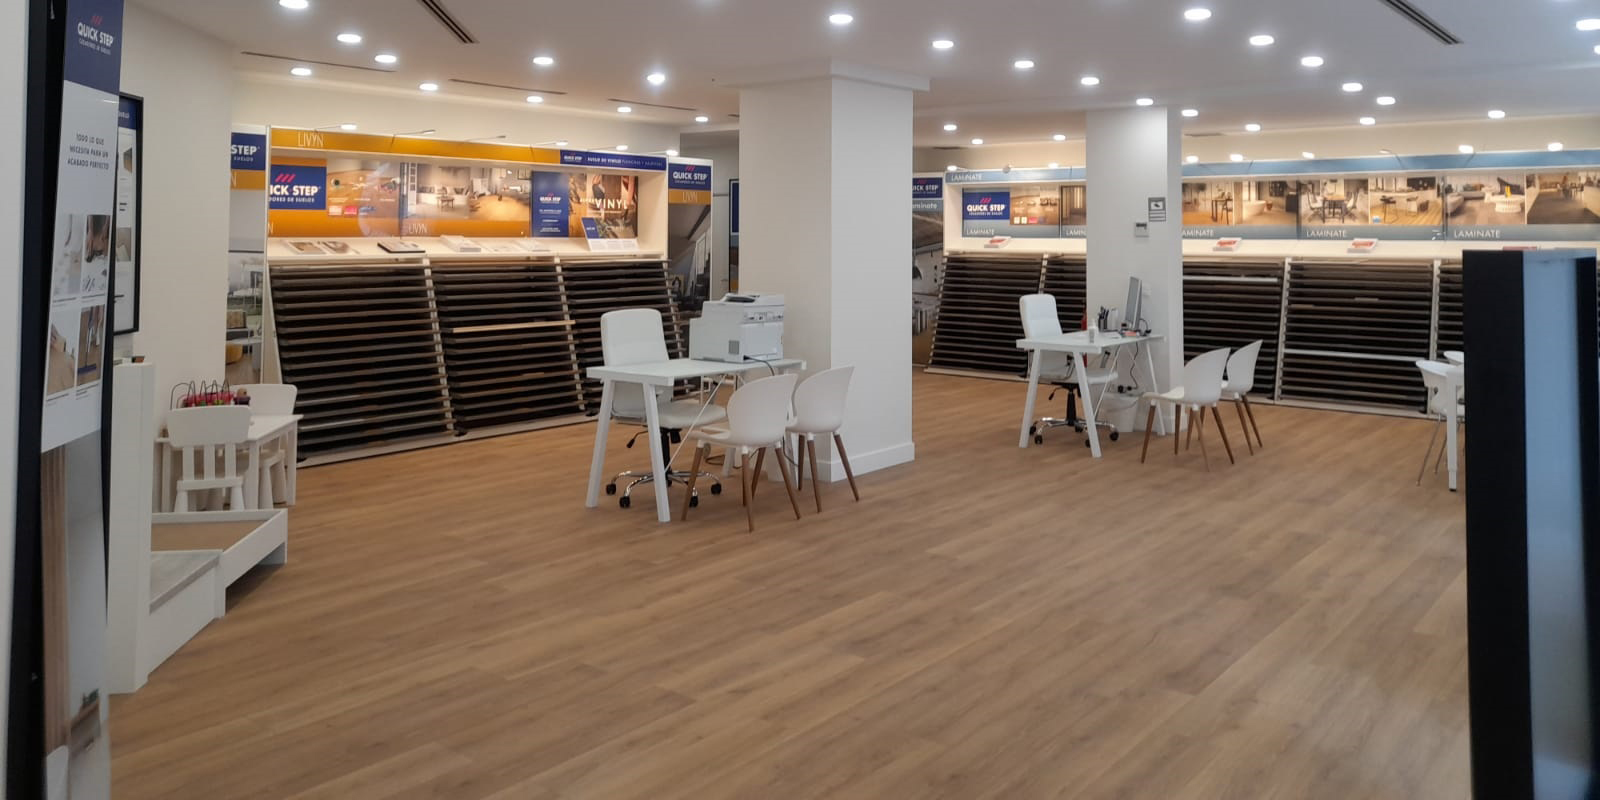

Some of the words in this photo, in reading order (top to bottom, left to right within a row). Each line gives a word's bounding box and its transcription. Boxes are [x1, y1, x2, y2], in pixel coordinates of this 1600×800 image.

[78, 22, 98, 42] QUICK
[99, 32, 114, 48] STEP
[298, 132, 324, 147] LIVYN
[231, 145, 257, 155] STEP
[672, 171, 692, 180] QUICK
[693, 173, 708, 181] STEP
[269, 184, 289, 195] ICK
[292, 185, 318, 196] STEP
[595, 198, 628, 210] VINYL
[912, 201, 937, 210] aminate
[966, 203, 988, 213] QUICK
[989, 204, 1006, 212] STEP
[1182, 228, 1214, 237] AMINATE
[1306, 229, 1347, 239] LAMINATE
[1454, 229, 1500, 239] LAMINATE
